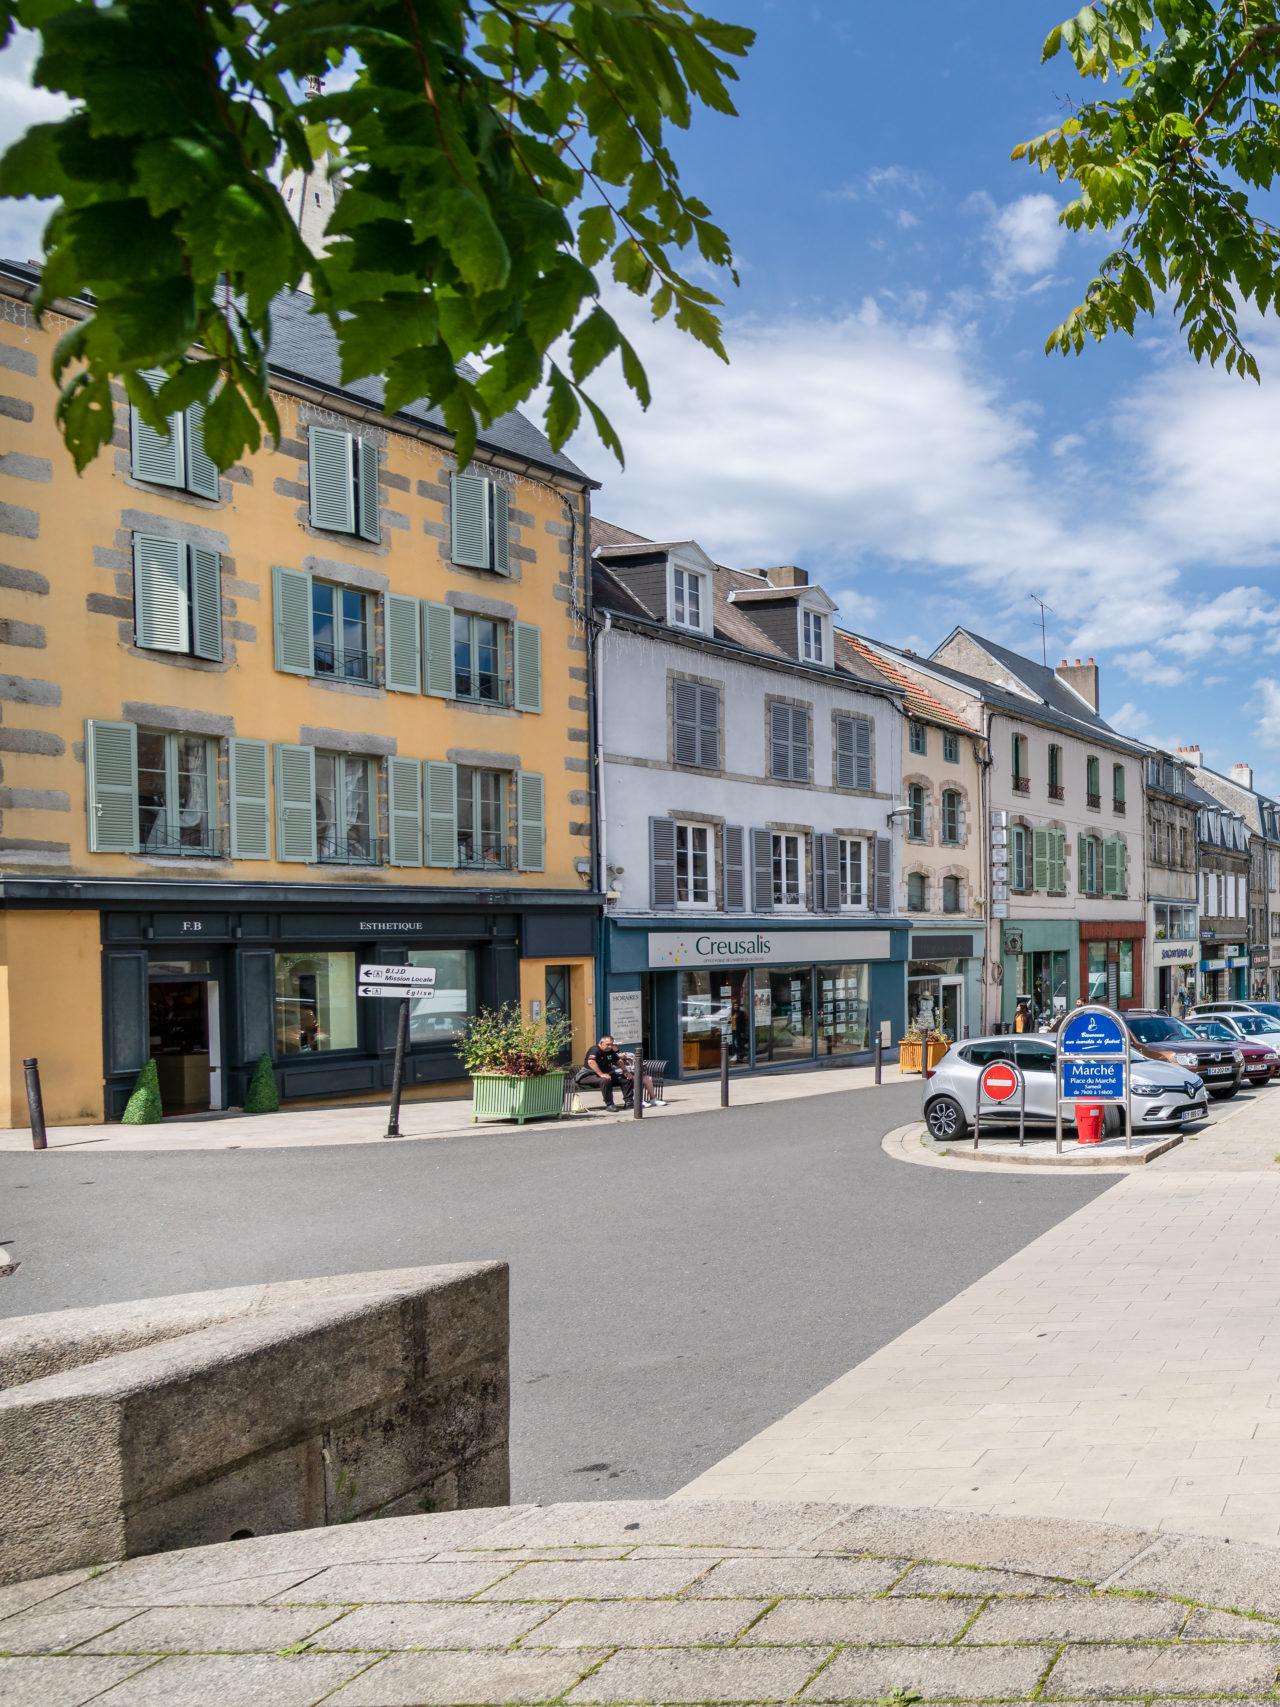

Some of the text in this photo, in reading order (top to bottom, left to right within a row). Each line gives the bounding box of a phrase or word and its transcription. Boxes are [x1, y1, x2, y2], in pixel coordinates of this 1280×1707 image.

[183, 921, 202, 931] F.B
[696, 934, 771, 956] Creusalis
[1072, 1065, 1115, 1075] Marché
